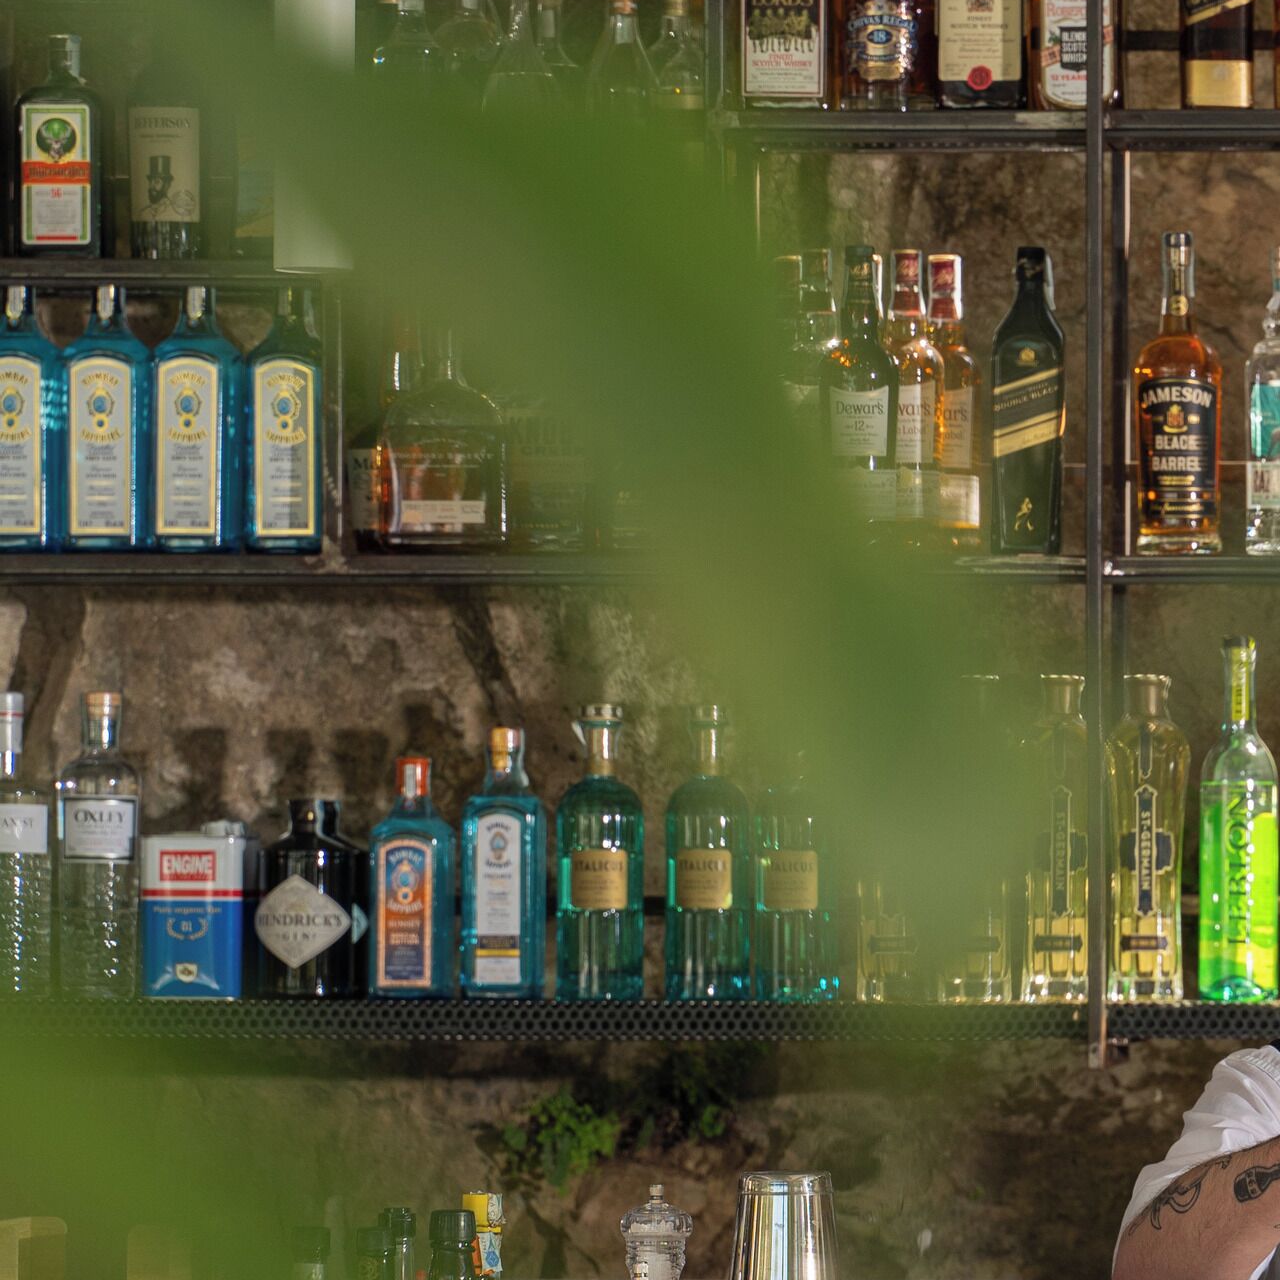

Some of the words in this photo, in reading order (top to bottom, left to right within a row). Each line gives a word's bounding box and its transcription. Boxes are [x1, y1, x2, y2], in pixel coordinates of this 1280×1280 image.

[872, 30, 887, 43] 18
[1061, 42, 1087, 53] SCOTC
[1030, 384, 1060, 401] BLACK
[1142, 385, 1213, 409] JAMESON
[836, 399, 885, 417] Dewar's
[854, 420, 866, 432] 12
[1154, 435, 1201, 451] BLACK
[1152, 456, 1202, 472] BARREL
[74, 809, 125, 824] OXLEY
[163, 854, 213, 874] ENGINE
[575, 860, 624, 873] ITALICUS
[1227, 795, 1250, 945] LEBLON
[258, 913, 343, 928] HENDRICK'S
